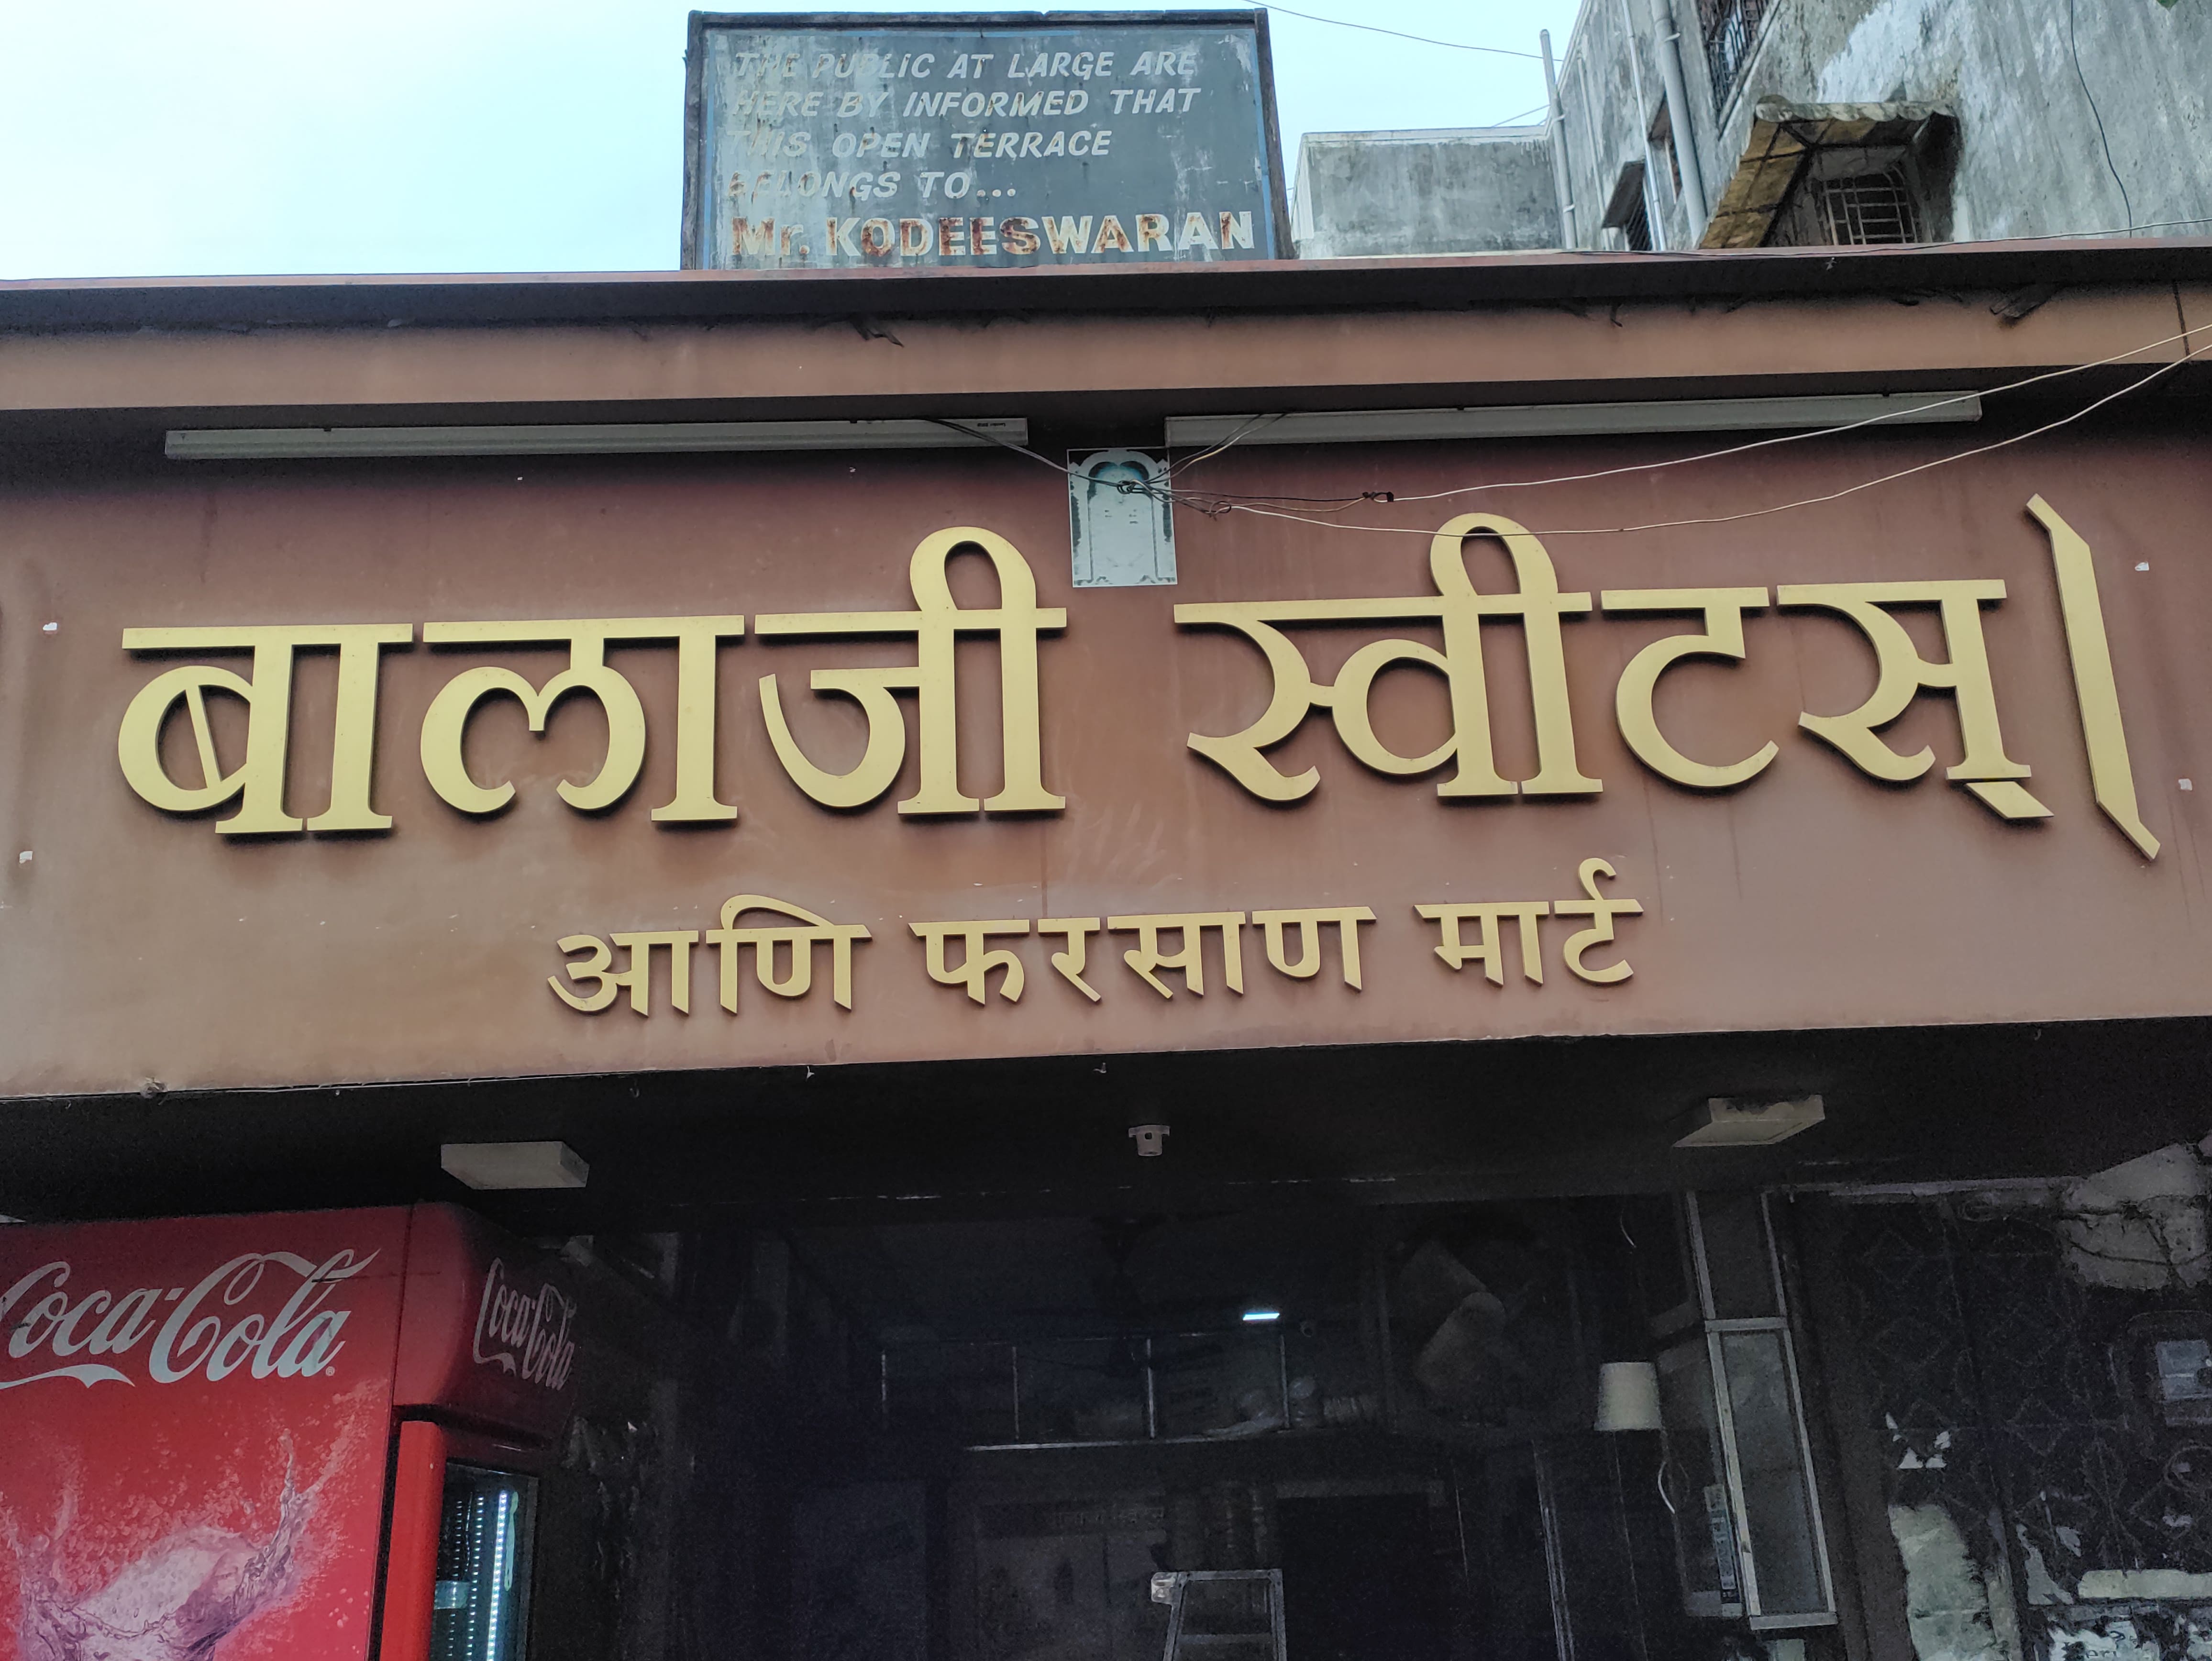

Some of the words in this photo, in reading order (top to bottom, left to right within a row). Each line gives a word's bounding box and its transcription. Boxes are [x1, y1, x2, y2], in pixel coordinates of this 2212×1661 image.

[736, 53, 800, 78] THE
[812, 53, 935, 78] PUBLIC
[947, 54, 994, 79] AT
[1008, 52, 1114, 80] LARGE
[1129, 51, 1199, 77] ARE
[732, 90, 824, 117] HERE
[837, 91, 889, 118] BY
[903, 89, 1089, 117] INFORMED
[1110, 88, 1201, 114] THAT
[727, 130, 811, 157] THIS
[832, 133, 931, 158] OPEN
[951, 130, 1112, 158] TERRACE
[728, 170, 901, 201] BELONGS
[731, 216, 810, 256] Mr.
[826, 211, 1255, 257] KODEESWARAN
[118, 526, 1068, 834] बालाजी
[547, 894, 871, 1016] आणि
[909, 906, 1375, 1006] फरसाण
[1415, 857, 1643, 986] मार्ट
